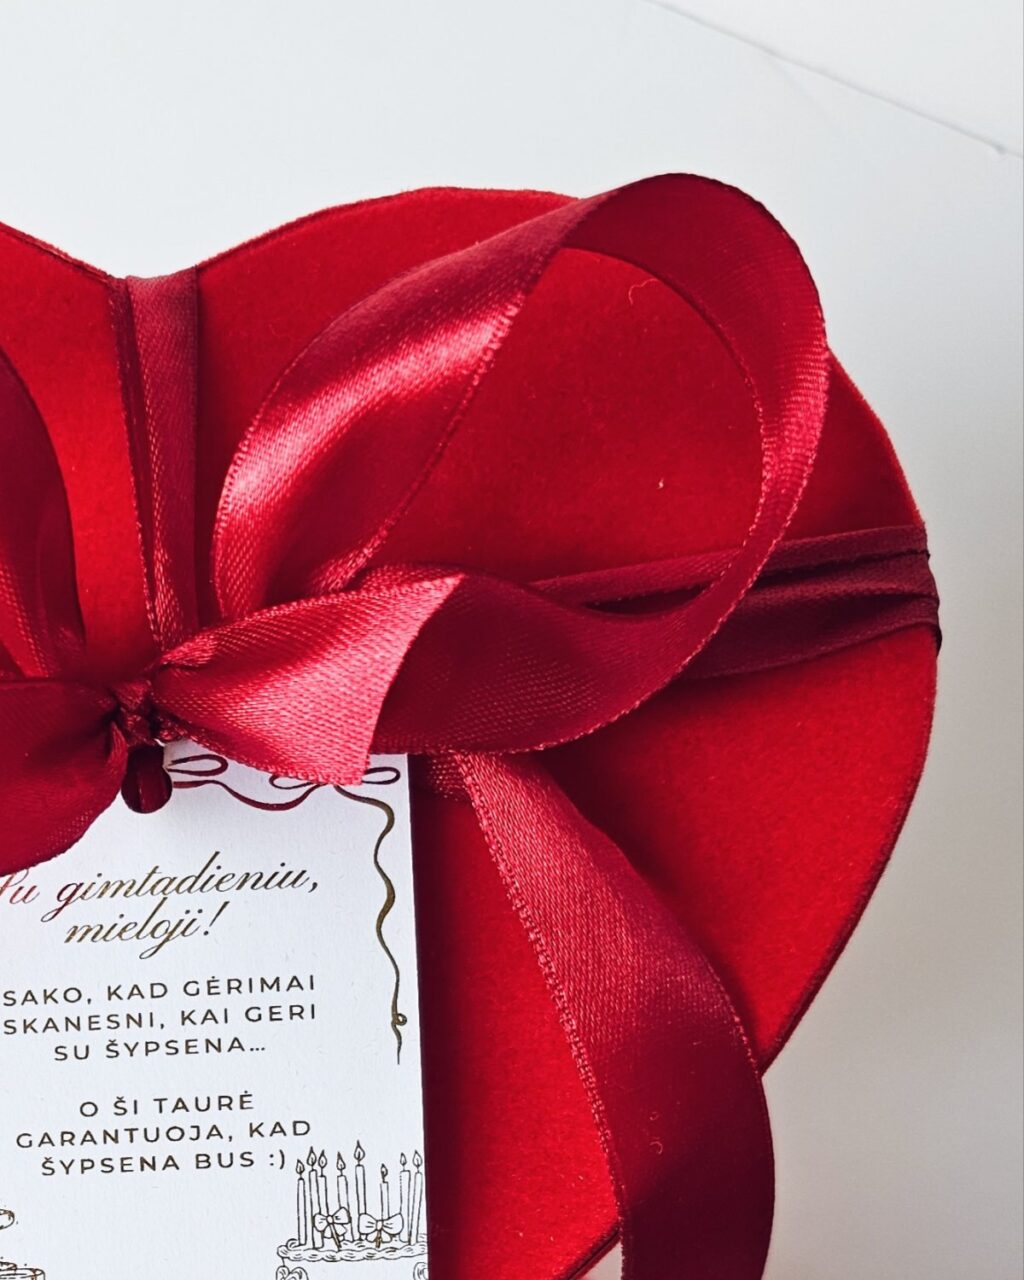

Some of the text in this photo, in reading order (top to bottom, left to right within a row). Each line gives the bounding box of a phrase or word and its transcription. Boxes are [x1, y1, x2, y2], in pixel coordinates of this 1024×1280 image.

[40, 850, 319, 923] gimtadieniu,
[64, 896, 230, 960] mieloji!
[2, 974, 315, 1007] SAKO, KAD GĖRIMAI
[3, 1003, 316, 1036] SKANESNI, KAI GERI
[54, 1044, 90, 1062] SU
[79, 1090, 254, 1118] O ŠI TAURĖ
[15, 1120, 311, 1149] GARANTUOJA, KAD
[41, 1154, 180, 1177] ŠYPSENA
[195, 1151, 255, 1170] BUS
